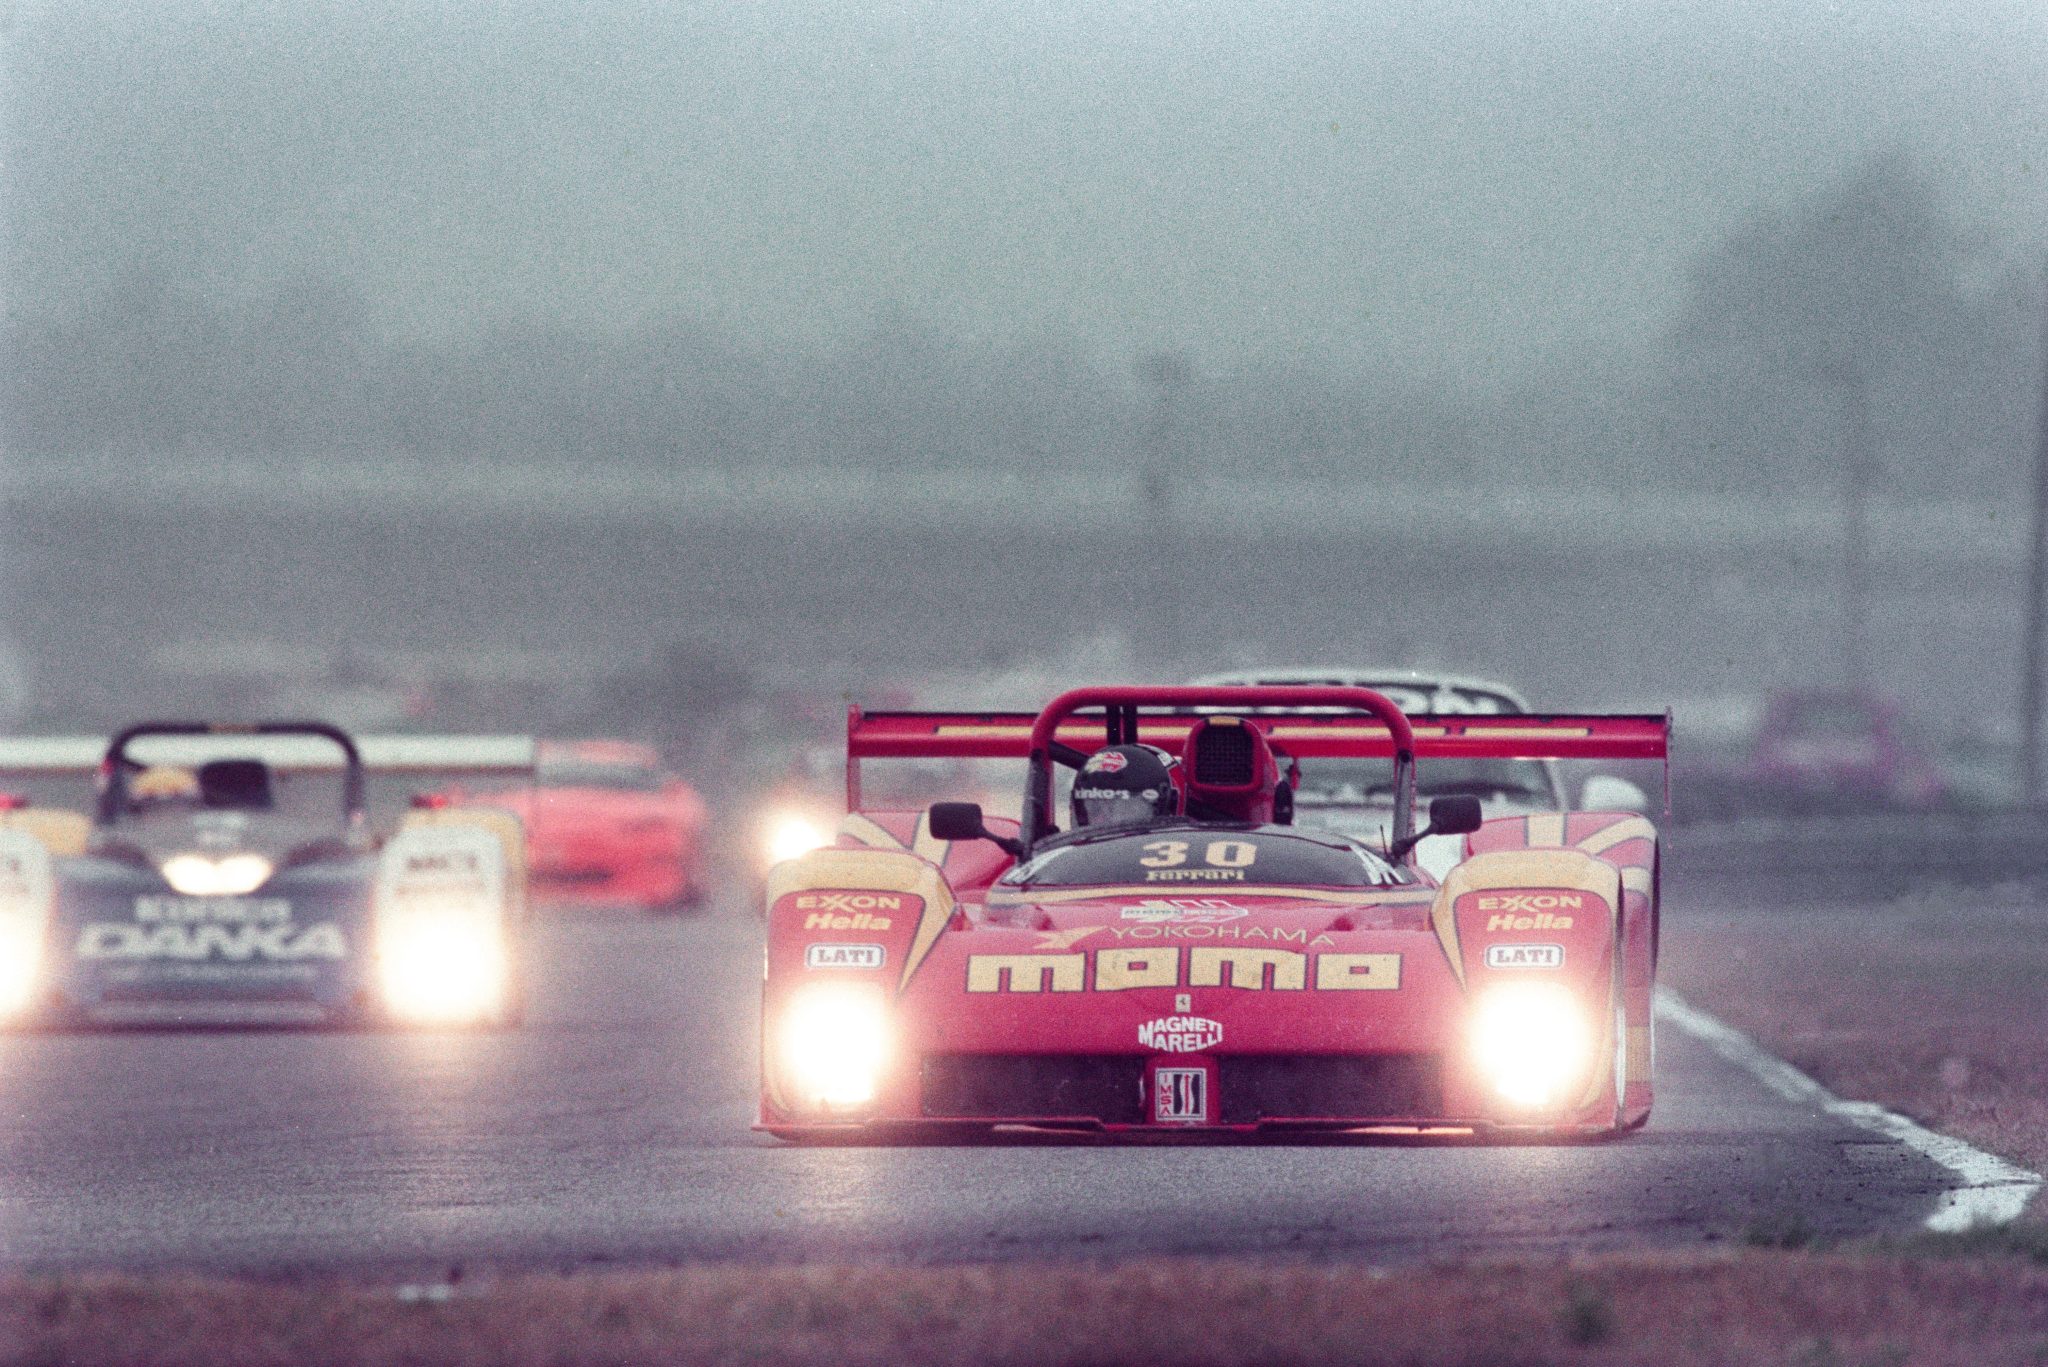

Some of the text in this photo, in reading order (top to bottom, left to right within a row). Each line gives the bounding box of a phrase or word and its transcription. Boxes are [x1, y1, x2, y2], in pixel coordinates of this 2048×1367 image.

[1140, 840, 1257, 867] 30
[1146, 868, 1245, 881] Ferrari
[797, 895, 901, 913] EXXON
[1479, 895, 1582, 913] EXXON
[804, 913, 892, 930] Hella
[1487, 912, 1574, 931] Hella
[77, 920, 346, 960] DANKA
[1108, 926, 1335, 946] YOKOHAMA
[817, 949, 875, 963] LATI
[1496, 949, 1554, 963] LATI
[965, 946, 1402, 994] momo
[1160, 1073, 1172, 1115] IMSA
